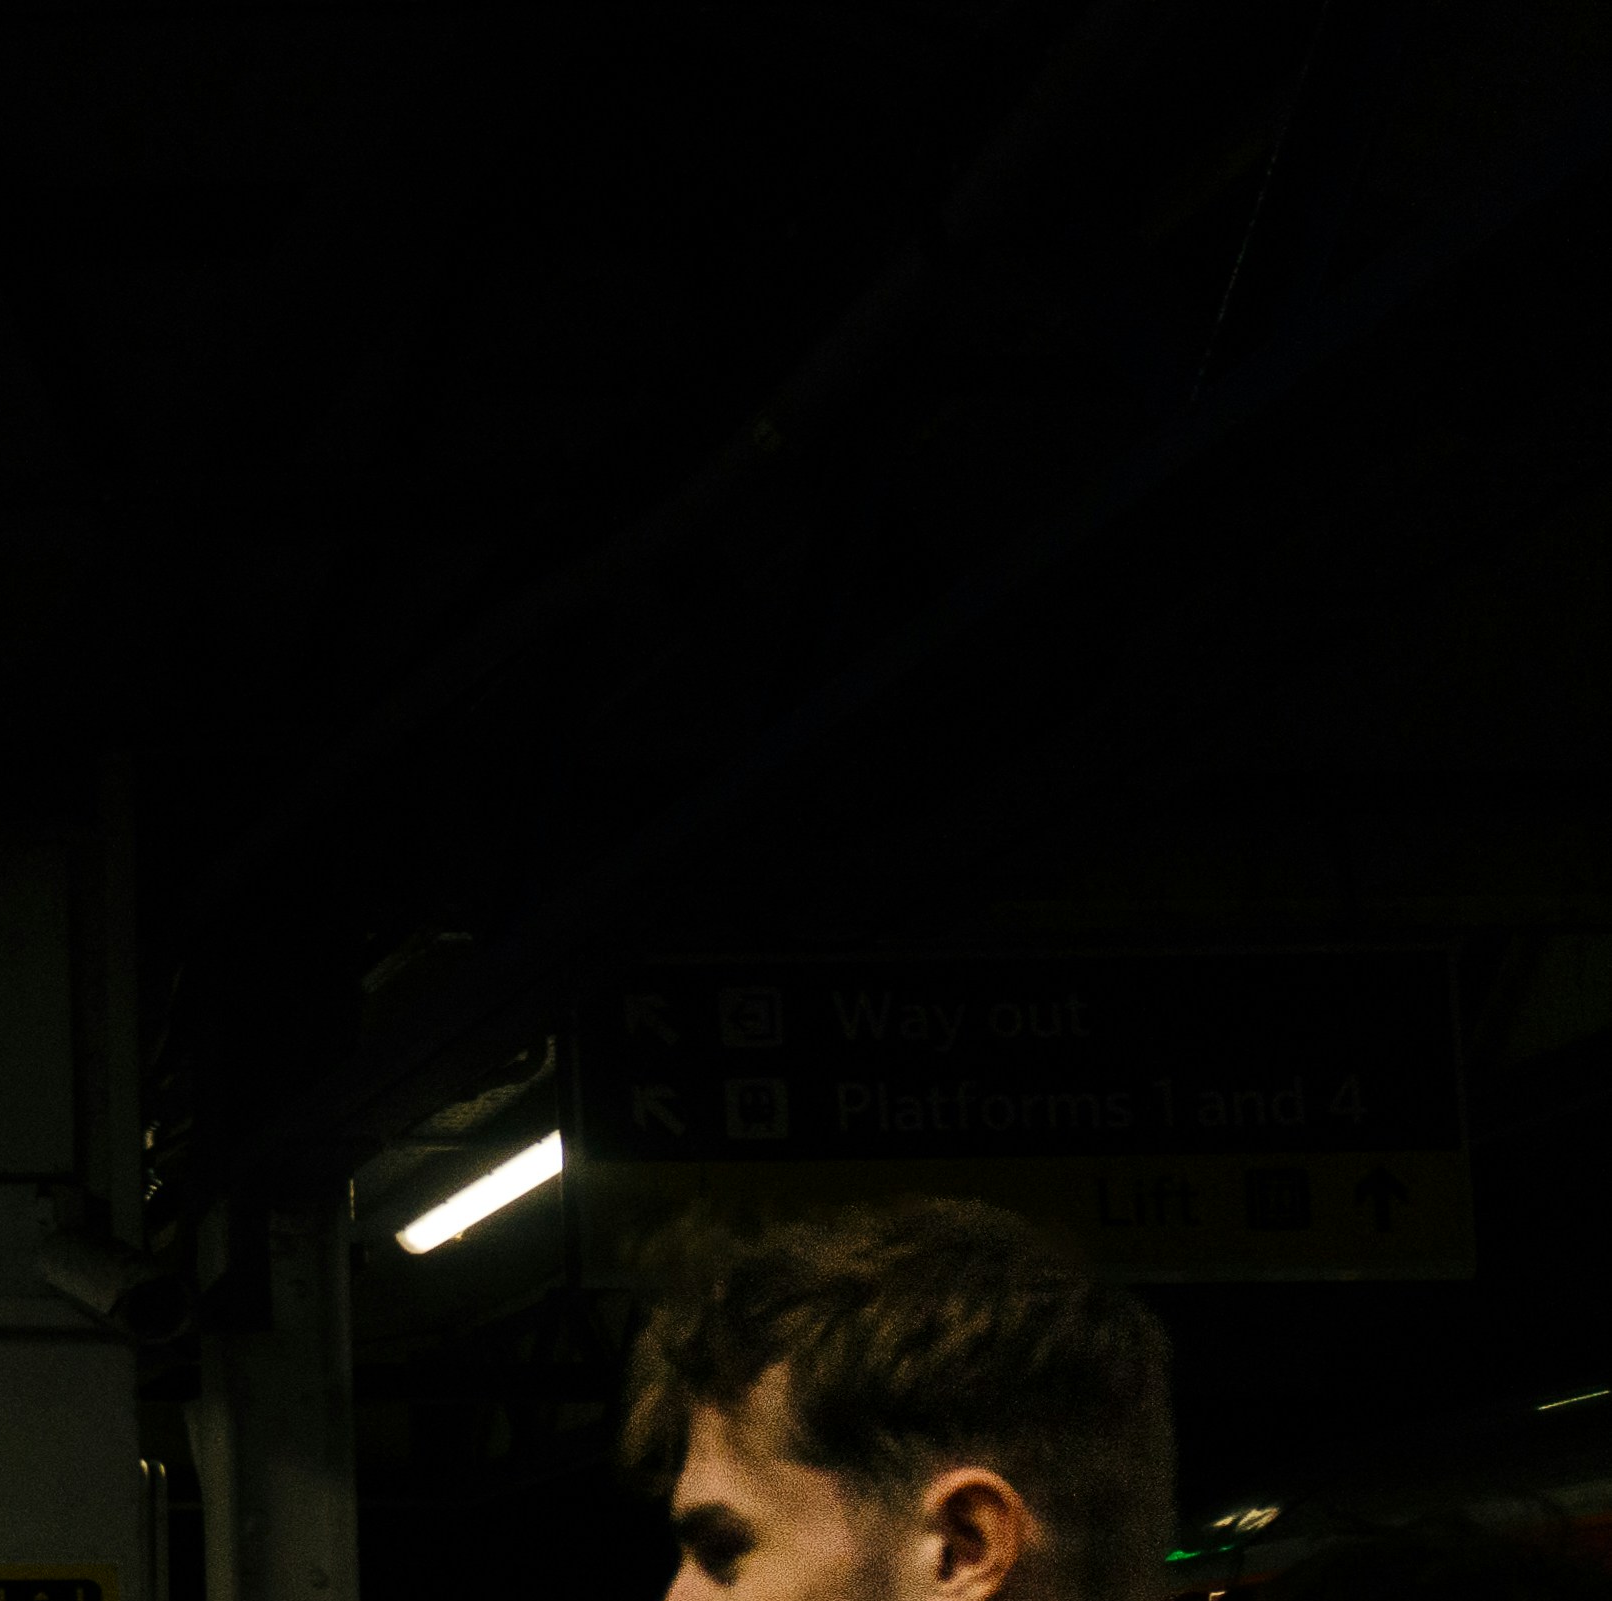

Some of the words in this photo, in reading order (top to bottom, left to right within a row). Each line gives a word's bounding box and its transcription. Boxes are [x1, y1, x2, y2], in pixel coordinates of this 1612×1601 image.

[833, 990, 969, 1053] Way
[989, 994, 1090, 1040] out
[837, 1078, 1132, 1136] Platforms
[1153, 1077, 1176, 1128] 1
[1197, 1075, 1306, 1128] and
[1329, 1073, 1368, 1124] 4
[1097, 1176, 1200, 1228] Lift
